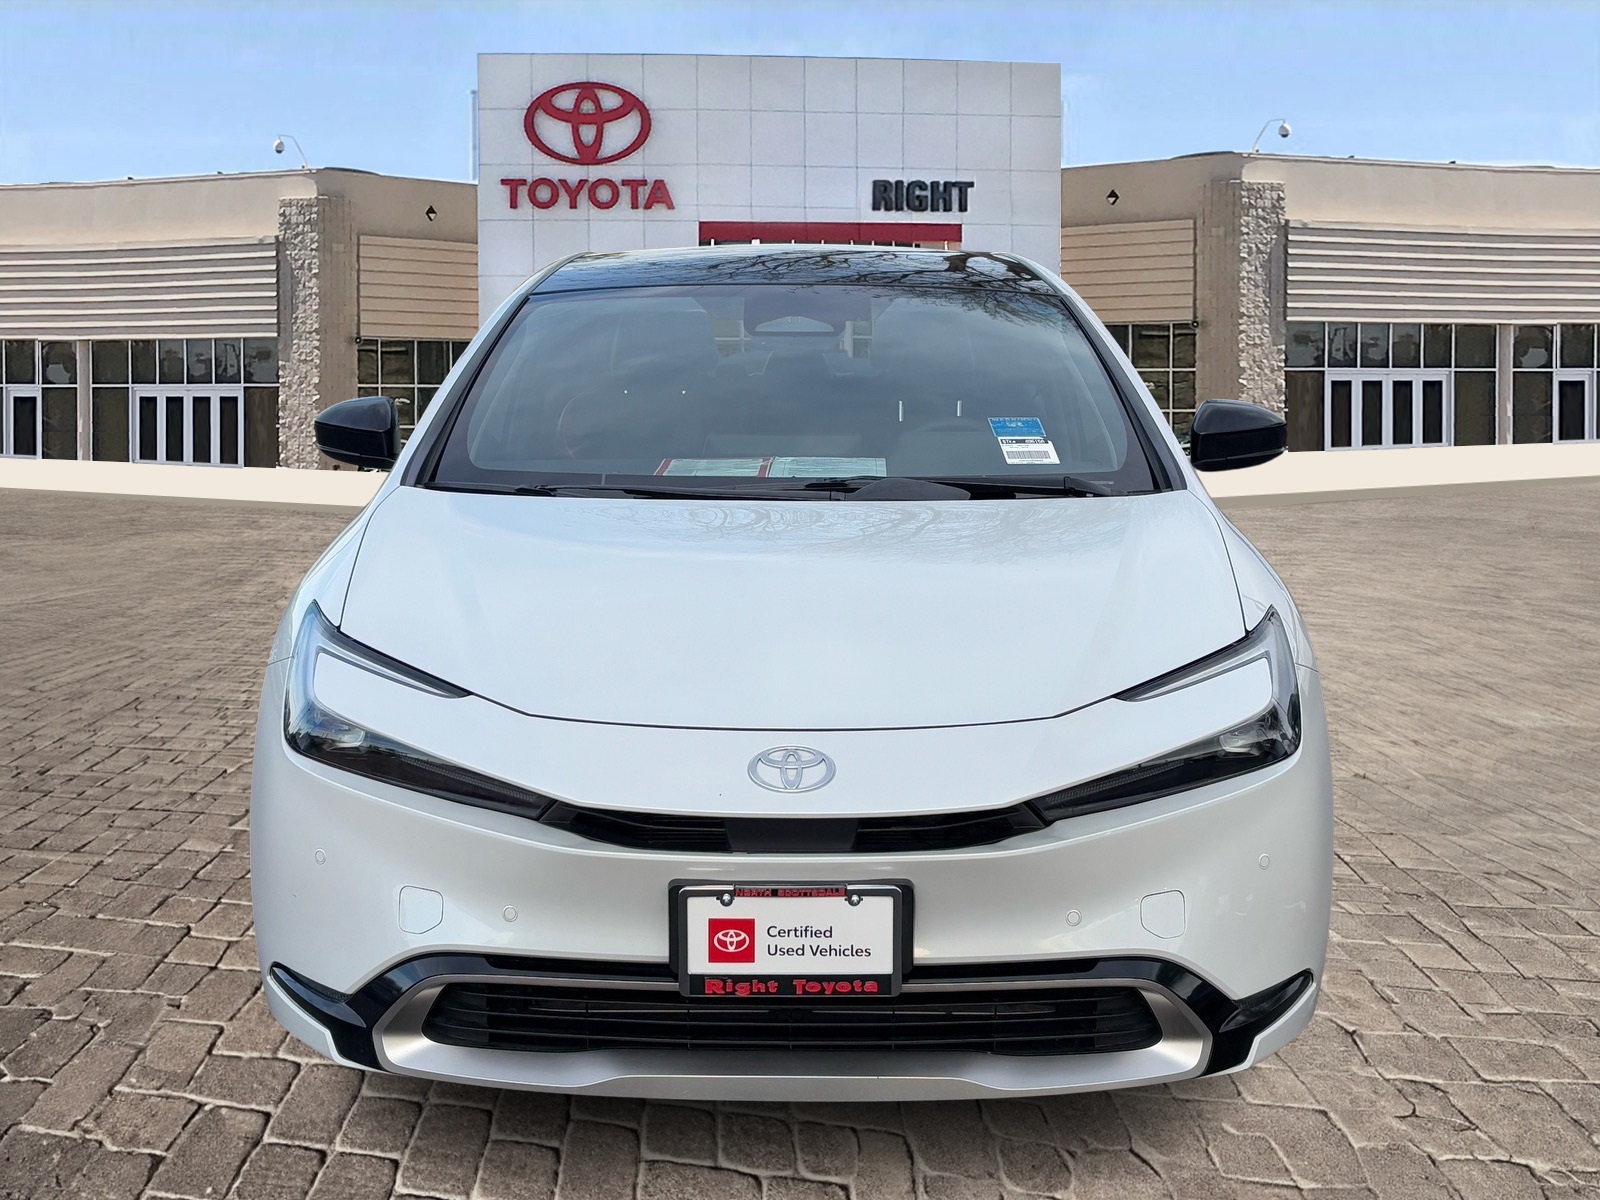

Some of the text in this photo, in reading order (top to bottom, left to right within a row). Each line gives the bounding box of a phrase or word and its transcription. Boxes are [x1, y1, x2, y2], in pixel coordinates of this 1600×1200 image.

[500, 178, 675, 210] TOYOTA
[871, 179, 975, 213] RIGHT
[766, 925, 833, 939] Certified
[767, 944, 872, 957] Used Vehicles
[704, 978, 878, 996] Right Toyota
